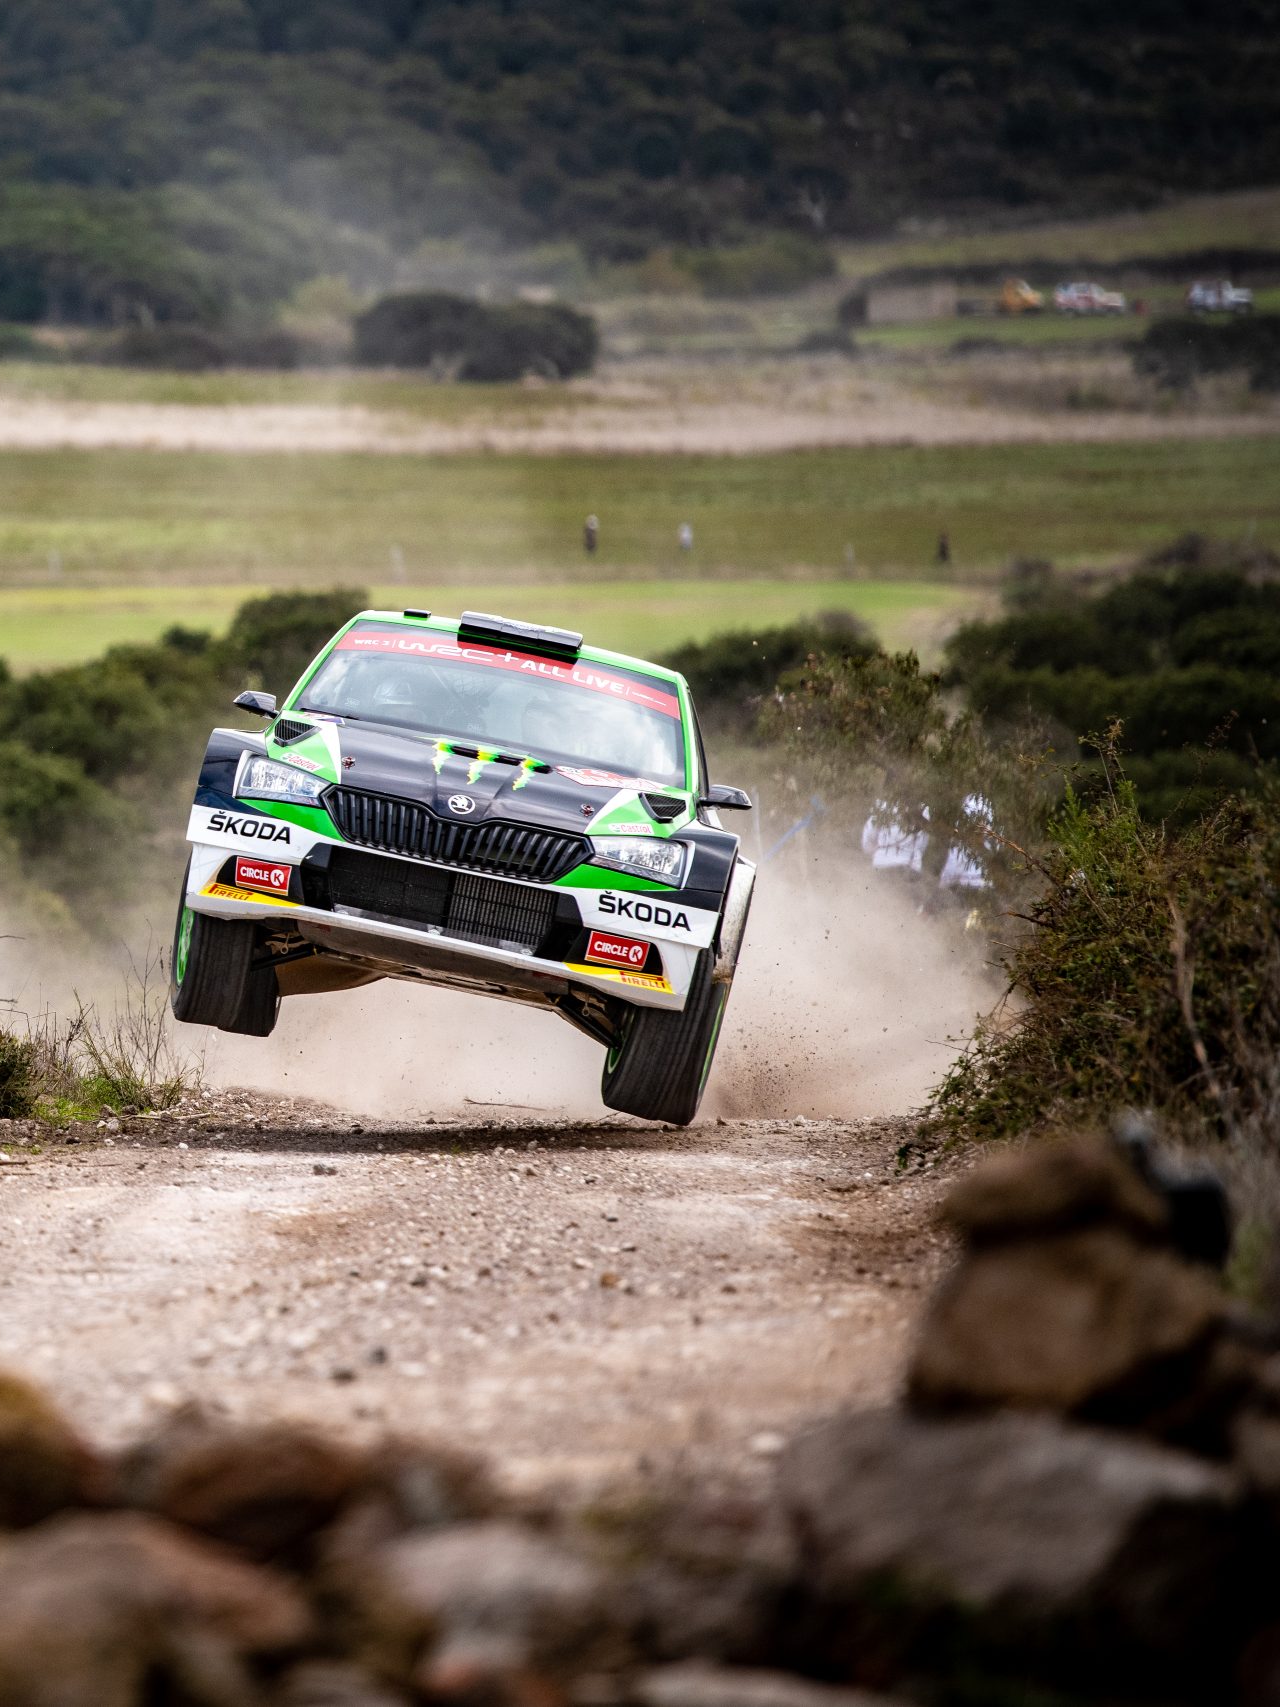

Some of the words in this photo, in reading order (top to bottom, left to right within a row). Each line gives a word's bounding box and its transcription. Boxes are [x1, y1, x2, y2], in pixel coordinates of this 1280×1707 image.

[520, 660, 566, 678] ALL
[573, 671, 625, 694] LIVE
[288, 755, 320, 771] Castrol
[207, 811, 291, 844] ŠKODA
[620, 825, 652, 834] Castrol
[240, 866, 269, 881] CIRCLE
[271, 869, 284, 886] K
[208, 884, 254, 900] PIRELLI
[598, 891, 691, 931] ŠKODA
[594, 941, 628, 957] CIRCLE
[629, 945, 643, 962] K
[620, 971, 665, 988] PIRELLI
